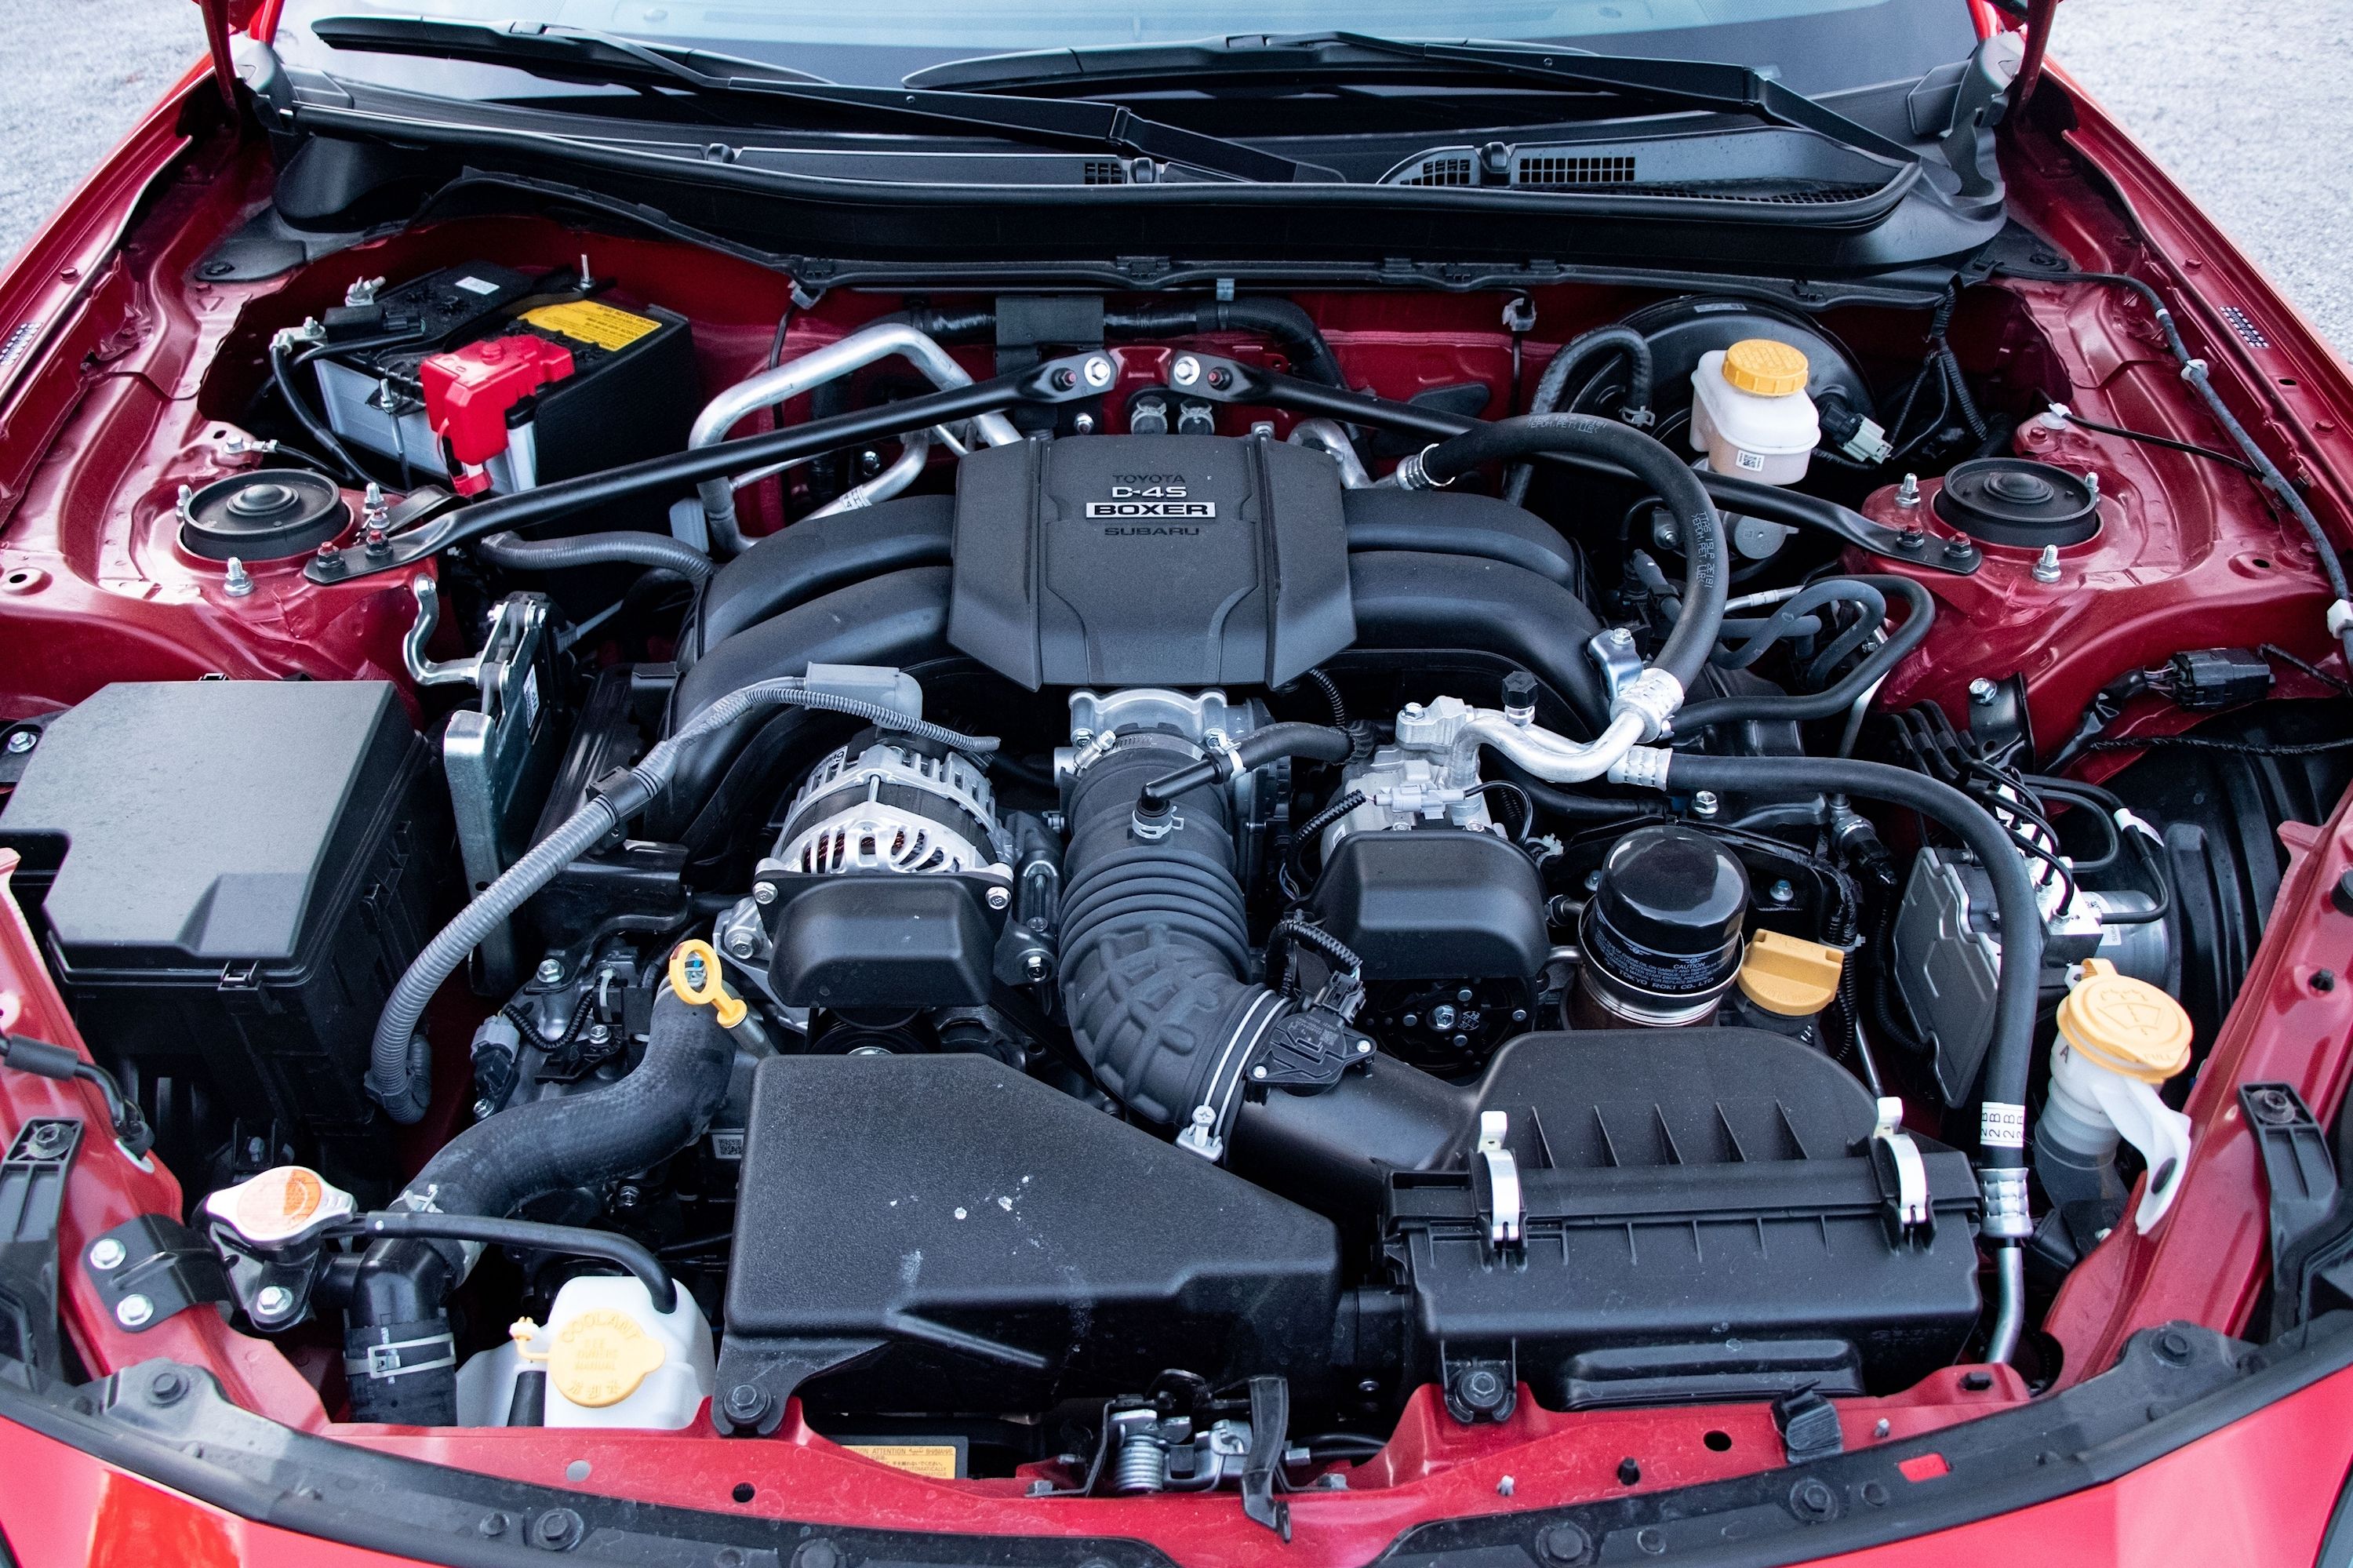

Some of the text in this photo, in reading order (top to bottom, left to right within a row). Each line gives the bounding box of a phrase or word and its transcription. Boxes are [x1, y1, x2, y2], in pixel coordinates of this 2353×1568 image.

[1112, 475, 1186, 483] TOYOTA
[1112, 486, 1187, 498] D-4S
[1094, 504, 1208, 515] BOXER
[1104, 527, 1199, 536] SUBARU
[1619, 969, 1648, 985] TOKYO
[560, 1312, 641, 1343] COOLANT
